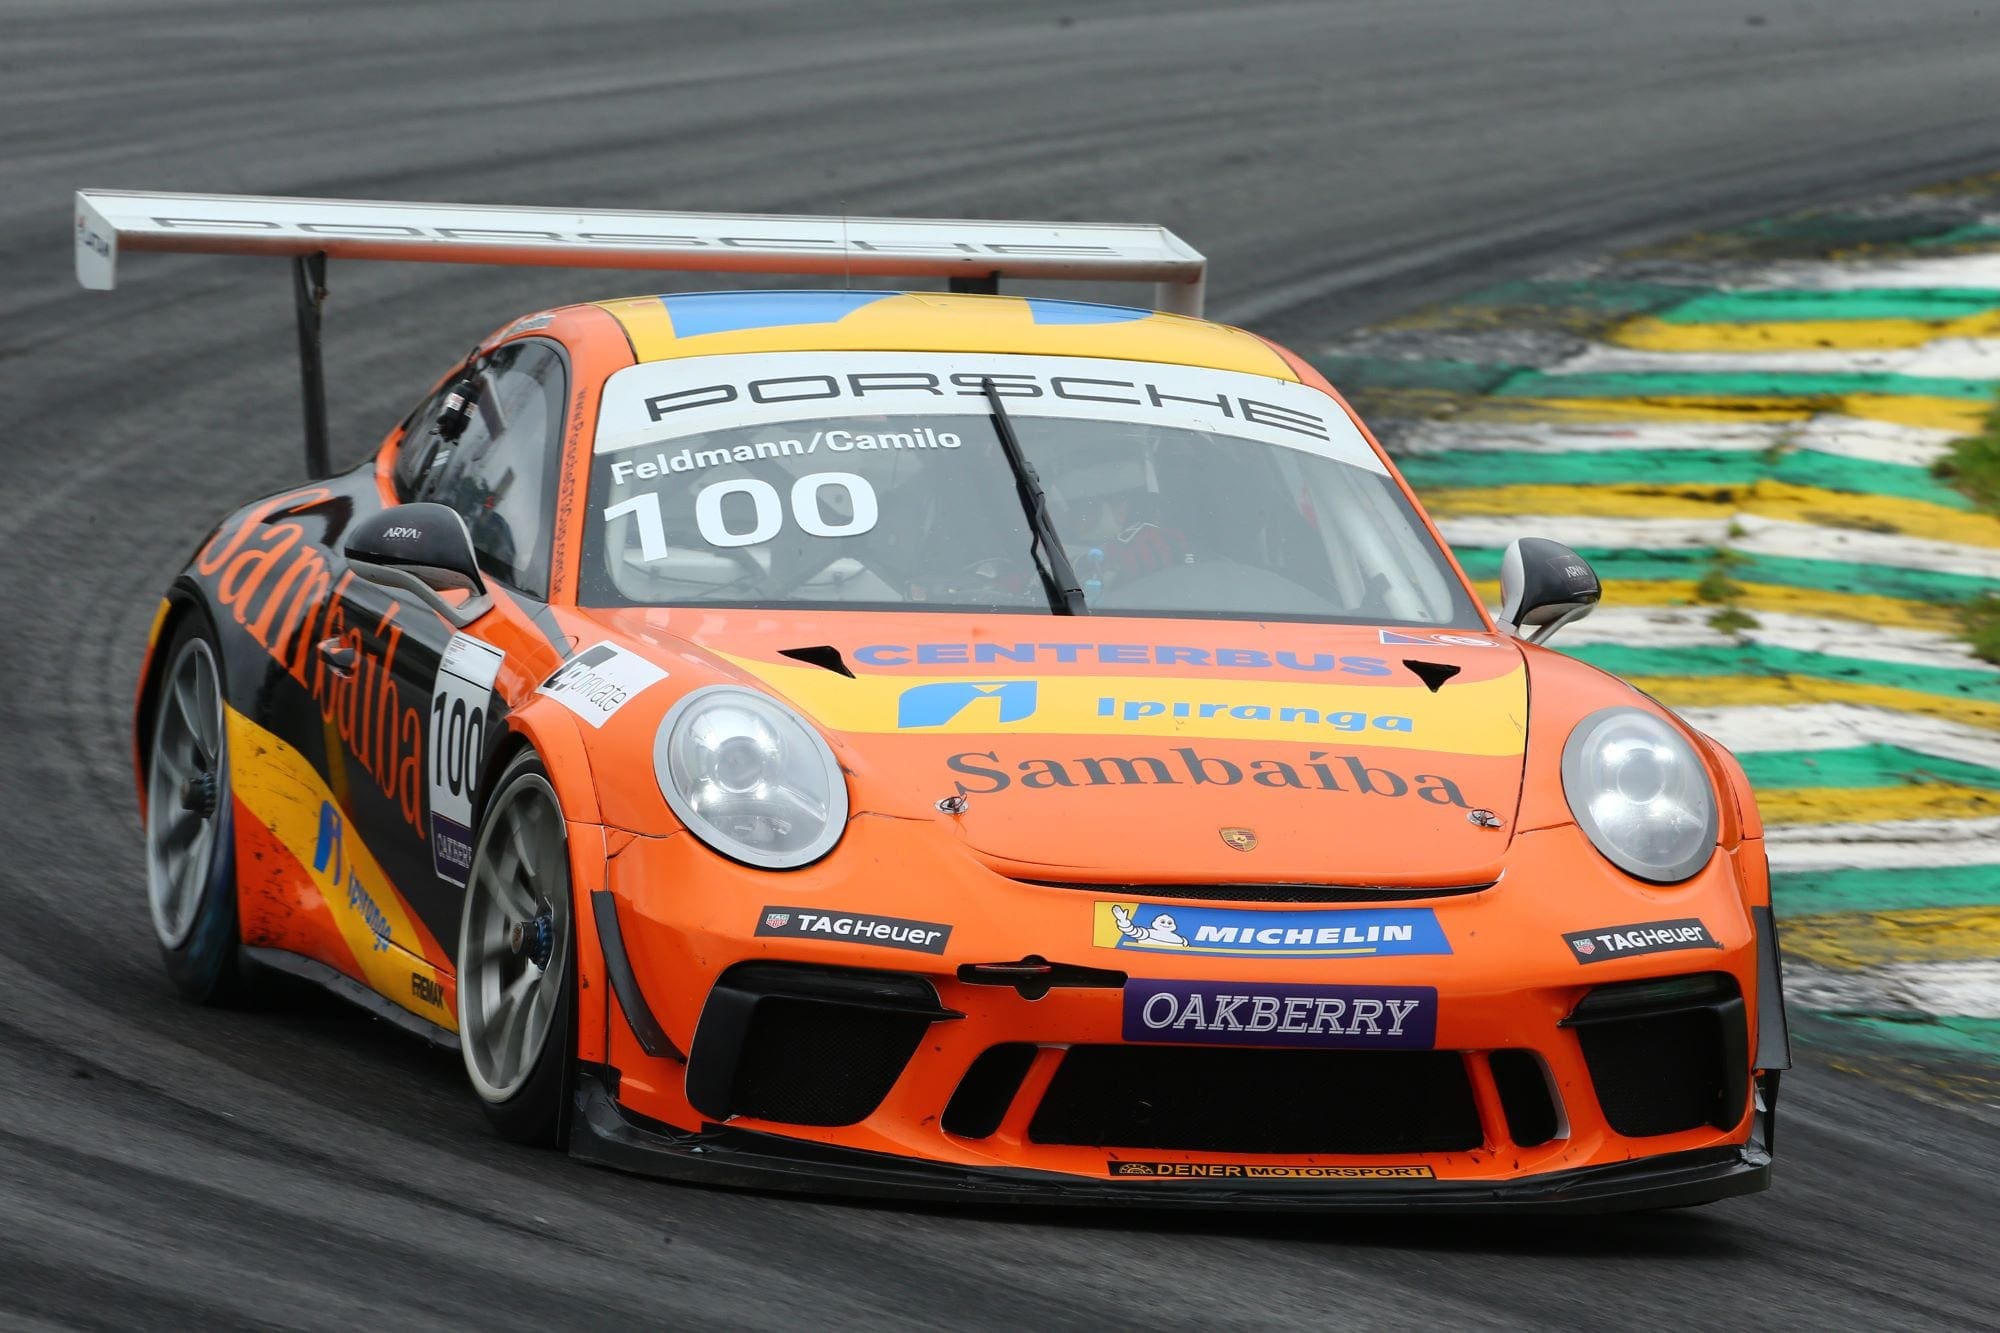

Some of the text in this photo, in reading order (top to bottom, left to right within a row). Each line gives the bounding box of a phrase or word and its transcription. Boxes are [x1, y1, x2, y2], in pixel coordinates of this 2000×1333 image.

[150, 216, 1123, 257] PORSCHE
[644, 371, 1330, 442] PORSCHE
[610, 427, 962, 486] Feldmann/Camilo
[603, 472, 879, 563] 100
[852, 642, 1393, 677] CENTERBUS
[1096, 696, 1413, 733] Ipiranga
[433, 690, 484, 805] 100
[945, 747, 1475, 810] Sambaíba
[1194, 924, 1413, 945] MICHELIN
[1142, 991, 1420, 1036] OAKBERRY
[1156, 1164, 1426, 1178] DENER MOTORSPORT
